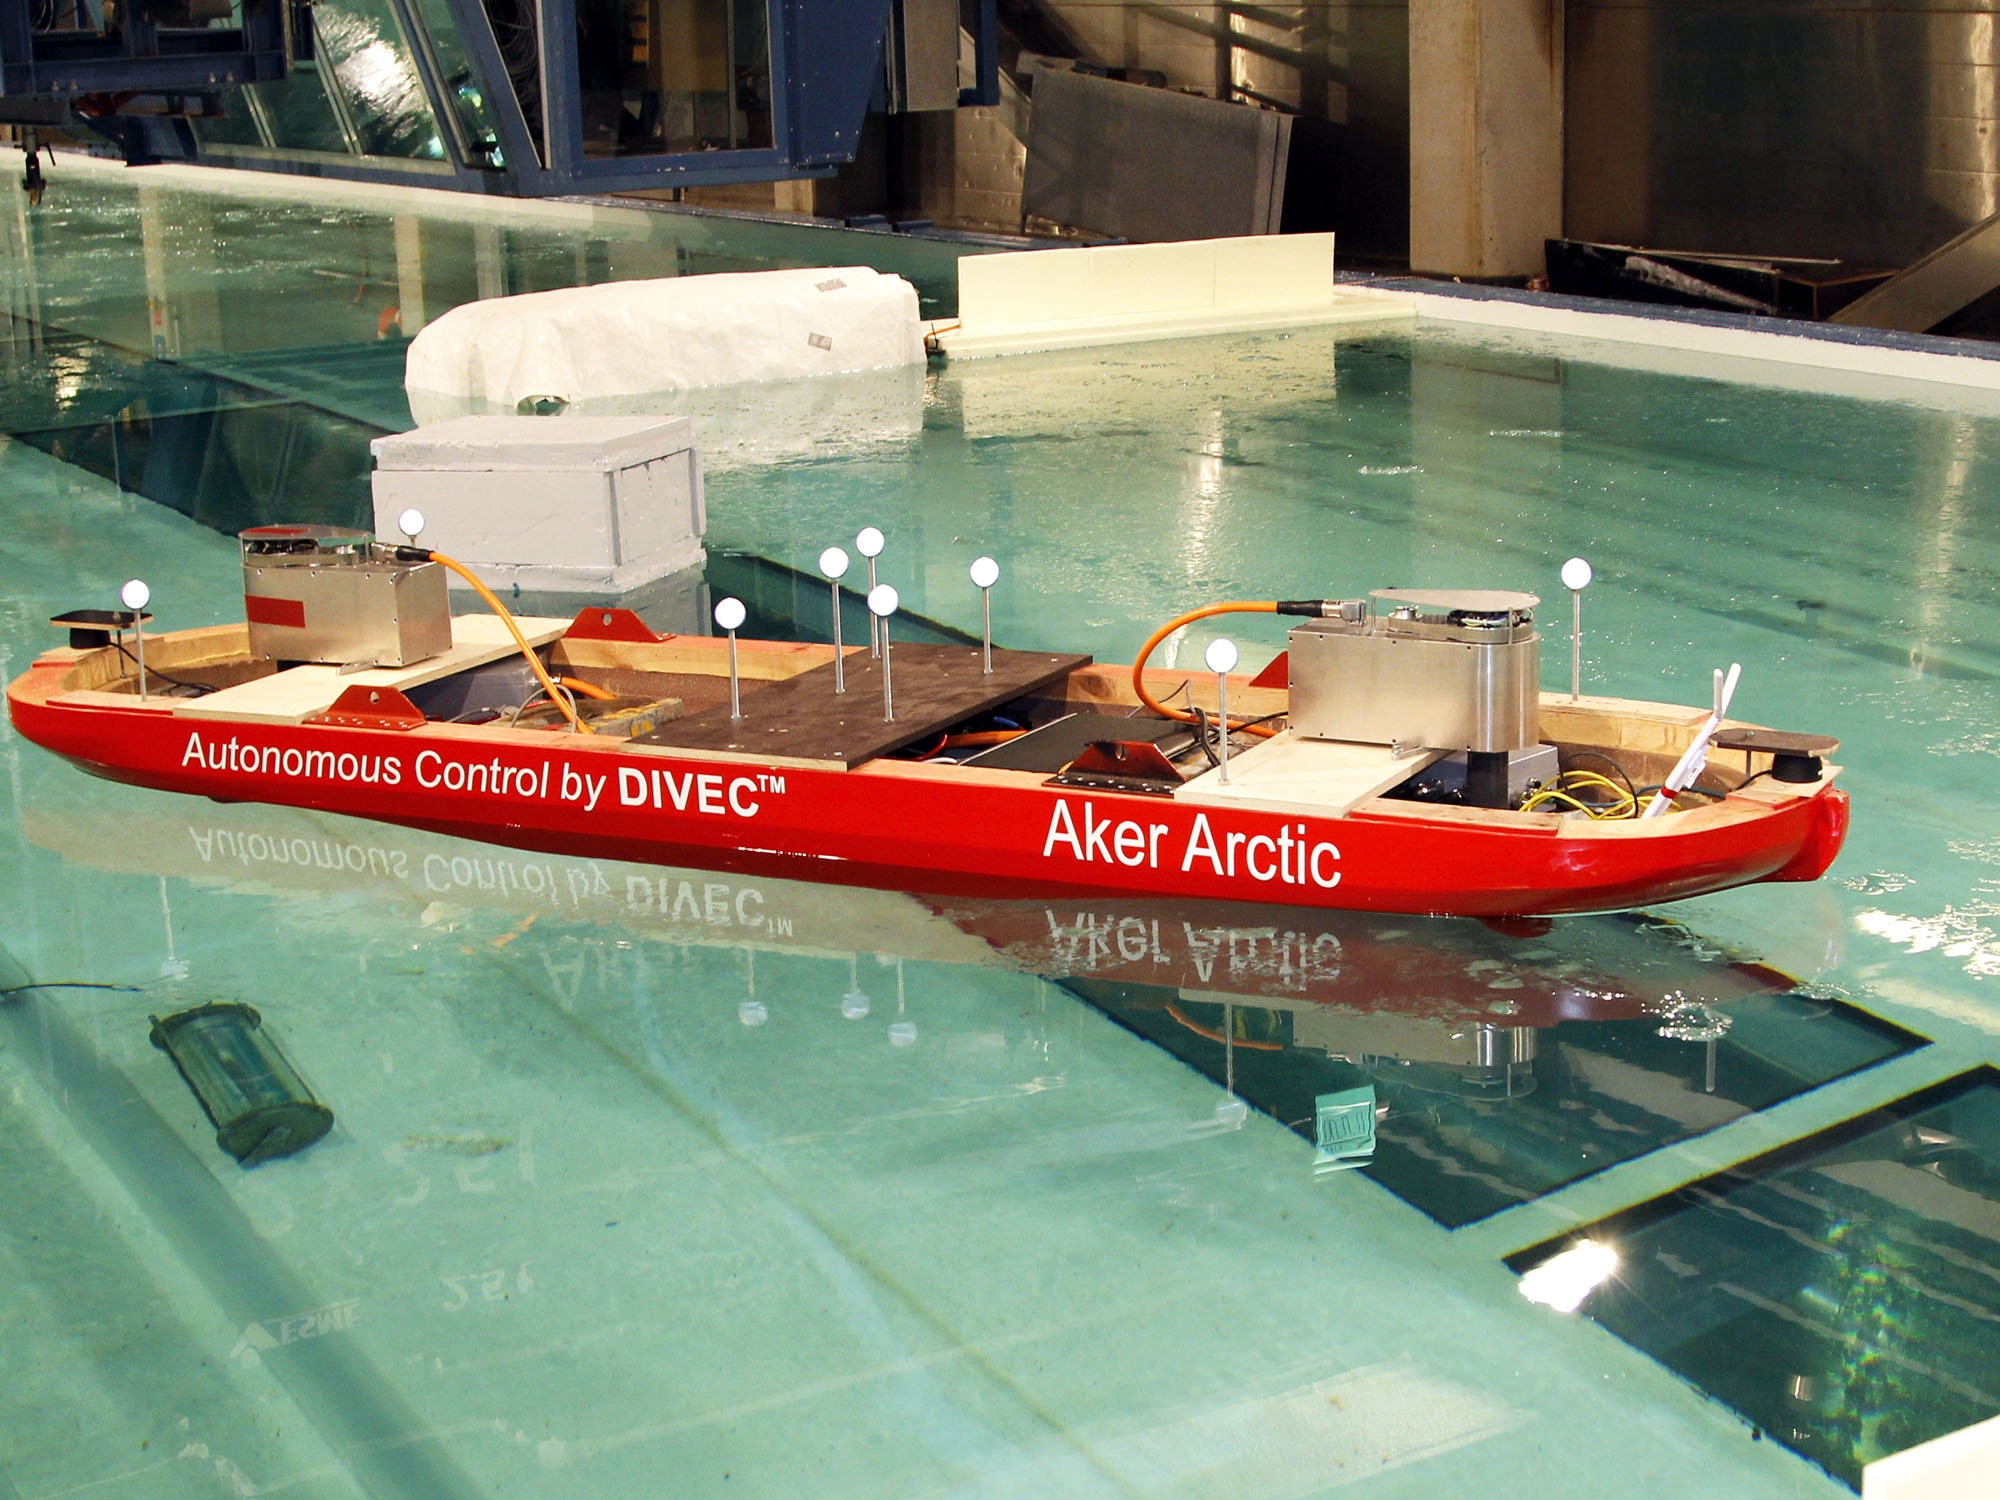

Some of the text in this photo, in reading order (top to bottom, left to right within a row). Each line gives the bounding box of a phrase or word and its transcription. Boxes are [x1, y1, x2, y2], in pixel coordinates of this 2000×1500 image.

[182, 732, 401, 785] Autonomous
[415, 750, 549, 798] Control
[560, 762, 607, 811] by
[1043, 799, 1342, 888] Aker Arctic
